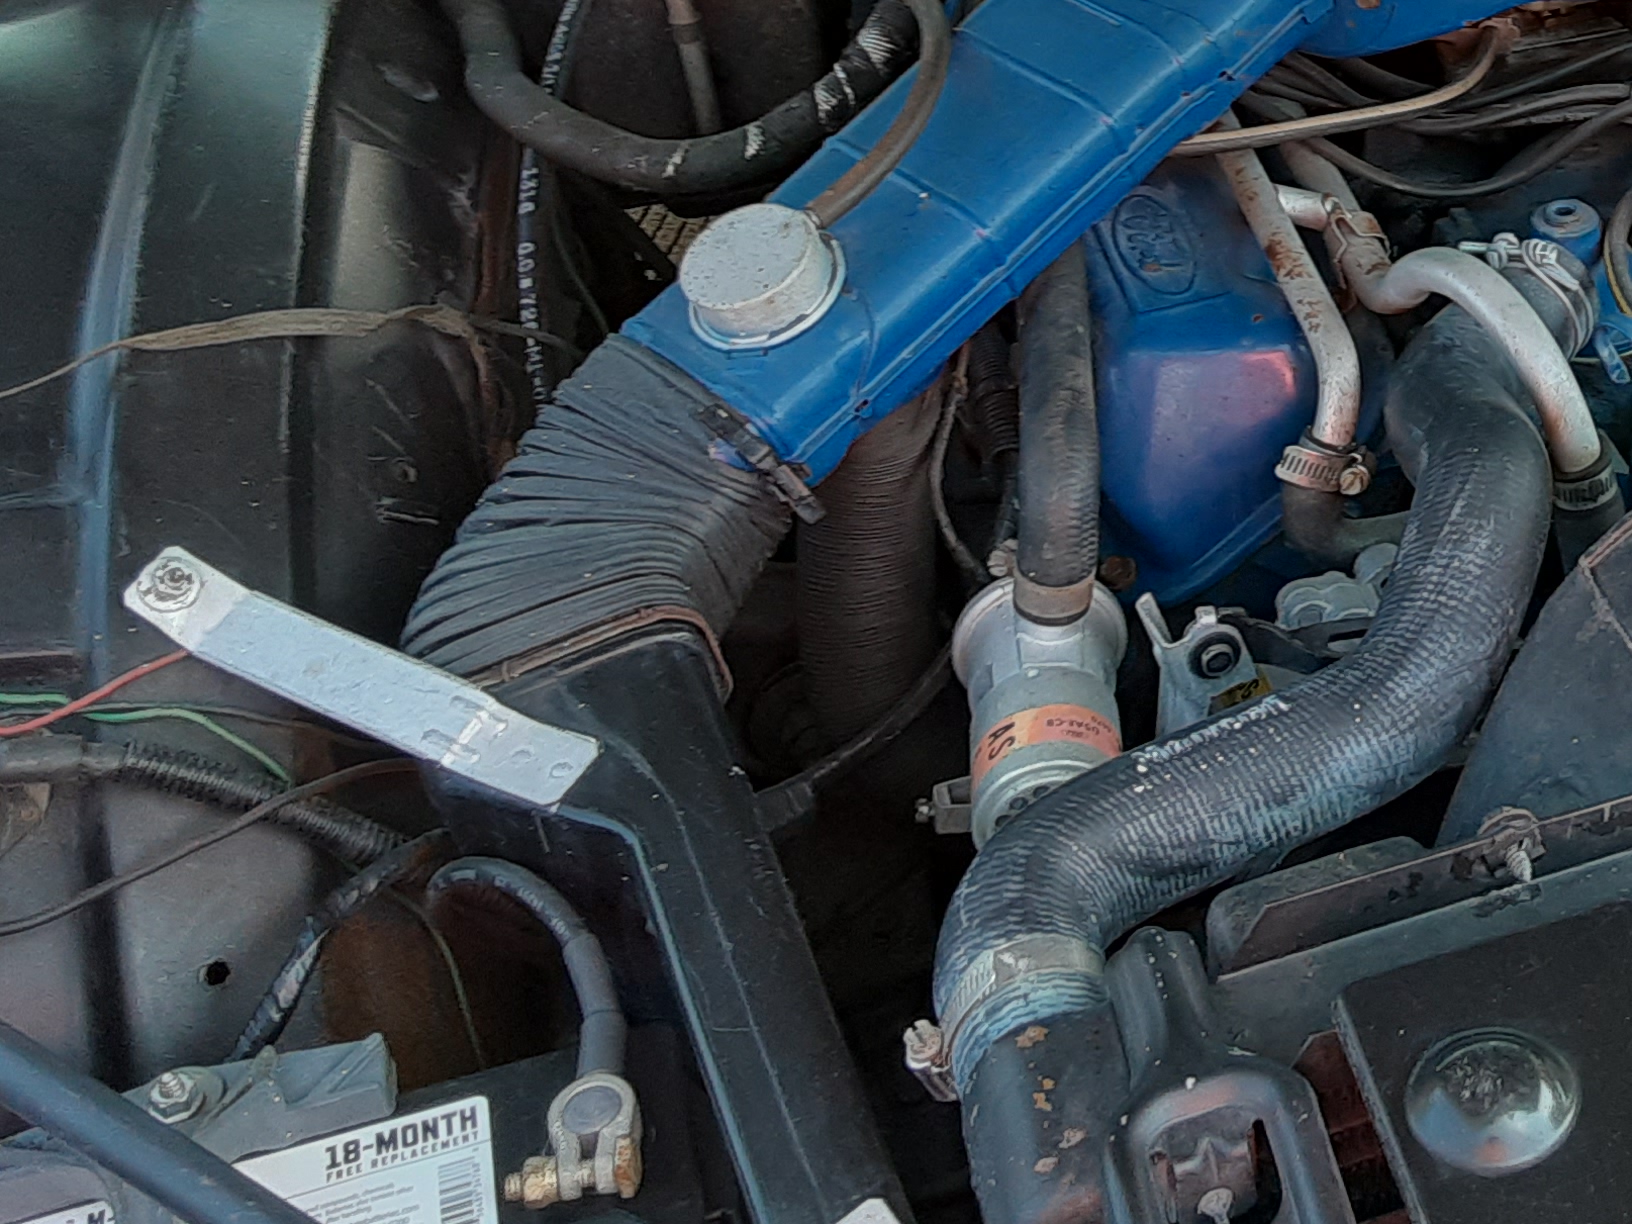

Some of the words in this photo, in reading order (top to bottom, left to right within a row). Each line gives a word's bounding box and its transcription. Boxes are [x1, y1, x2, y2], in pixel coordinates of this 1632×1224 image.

[325, 1105, 478, 1171] 18-MONTH
[326, 1162, 363, 1184] FREE
[370, 1130, 479, 1169] REPLACEMENT
